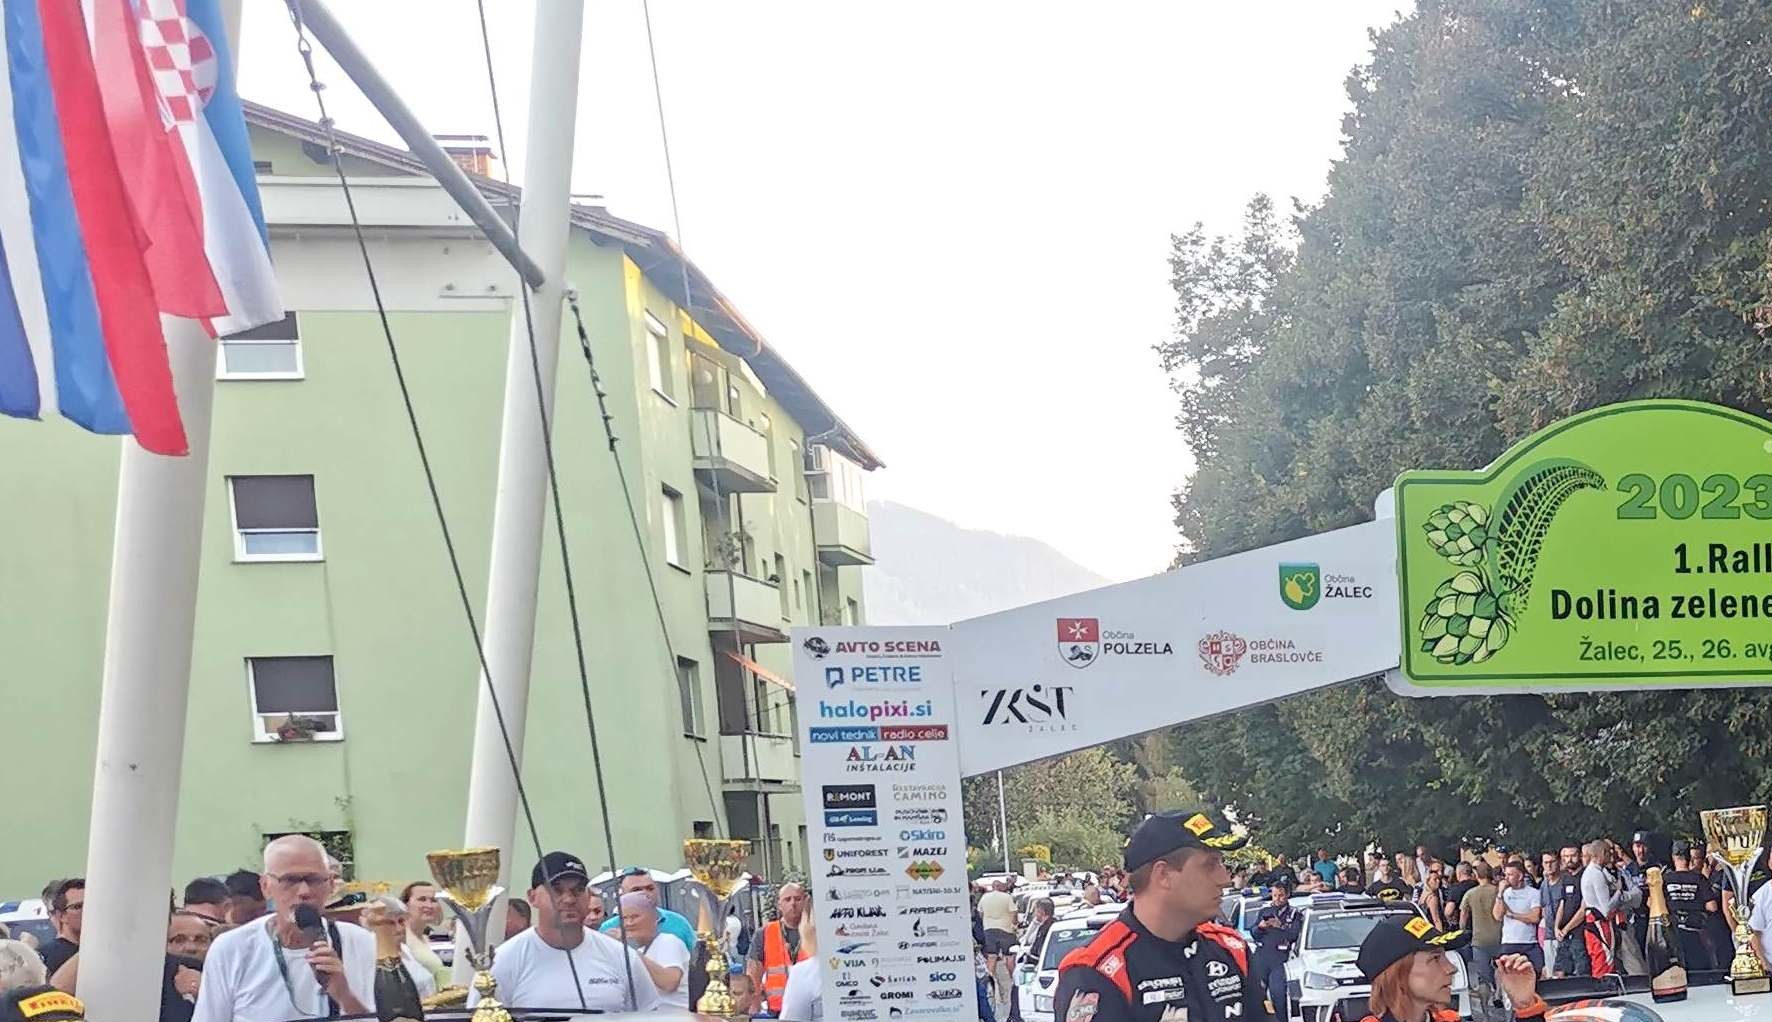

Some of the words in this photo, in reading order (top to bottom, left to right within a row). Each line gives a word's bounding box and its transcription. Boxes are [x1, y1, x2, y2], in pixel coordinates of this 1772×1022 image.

[1325, 584, 1373, 599] ŽALEC
[1552, 588, 1659, 621] Dolina
[836, 641, 880, 653] AVTO
[885, 640, 941, 653] SCENA
[1103, 641, 1174, 656] POLZELA
[1249, 638, 1296, 652] OBČINA
[1579, 638, 1645, 665] Žalec,
[1652, 640, 1695, 664] 25.,
[1702, 639, 1738, 660] 26.
[1250, 651, 1323, 664] BRASLOVČE
[852, 666, 921, 682] PETRE
[820, 700, 932, 722] halopixi.si
[812, 731, 839, 741] novi
[841, 729, 876, 740] tednik
[883, 728, 915, 740] radio
